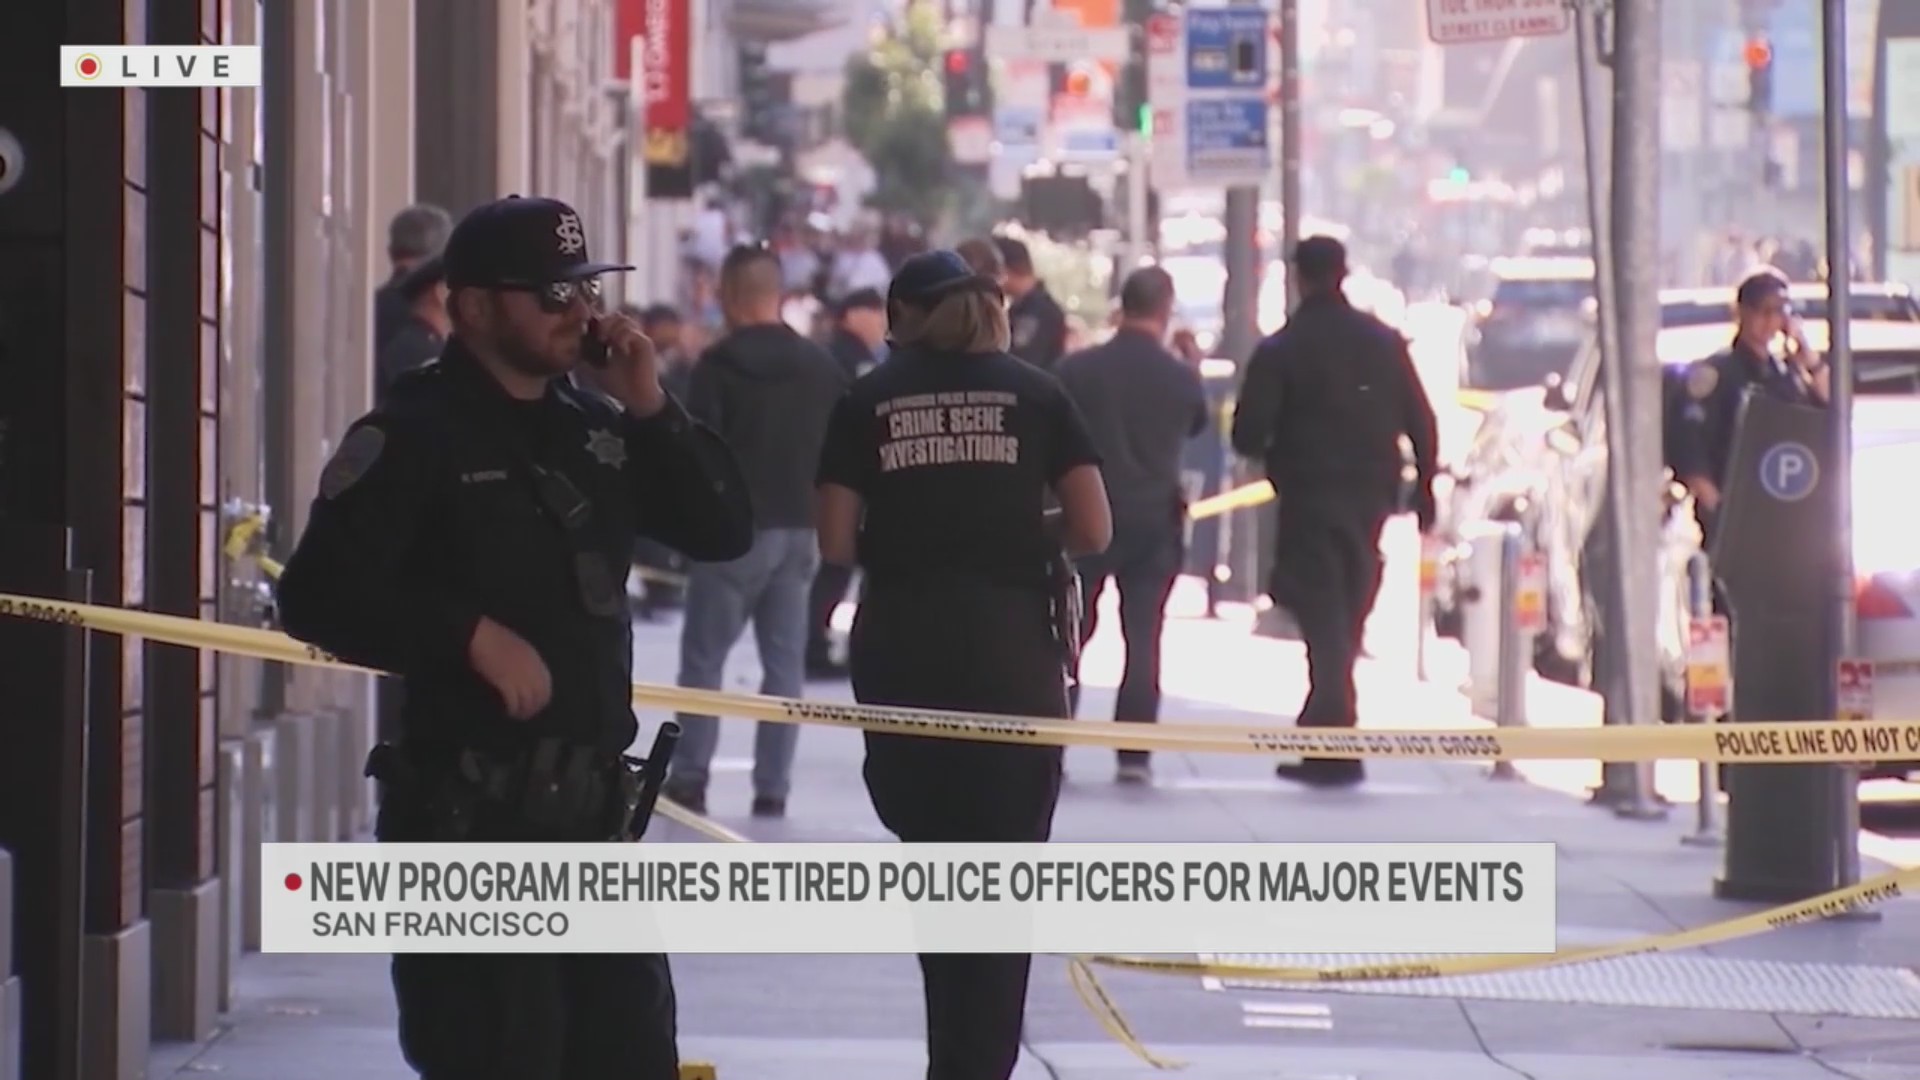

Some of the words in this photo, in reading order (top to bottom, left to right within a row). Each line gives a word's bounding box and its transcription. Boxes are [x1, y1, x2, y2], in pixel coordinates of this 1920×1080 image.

[1440, 21, 1489, 36] STREET
[889, 407, 945, 439] CRIME
[950, 406, 1004, 433] SCENE
[1779, 454, 1803, 488] P
[1248, 733, 1318, 750] POLICE
[1319, 734, 1364, 752] LINE
[1365, 735, 1393, 753] DO
[1395, 735, 1435, 754] NOT
[1439, 734, 1502, 755] CROSS
[1715, 730, 1782, 756] POLICE
[1785, 728, 1828, 755] LINE
[1831, 728, 1857, 753] DO
[1862, 727, 1899, 753] NOT
[1905, 726, 1920, 752] C
